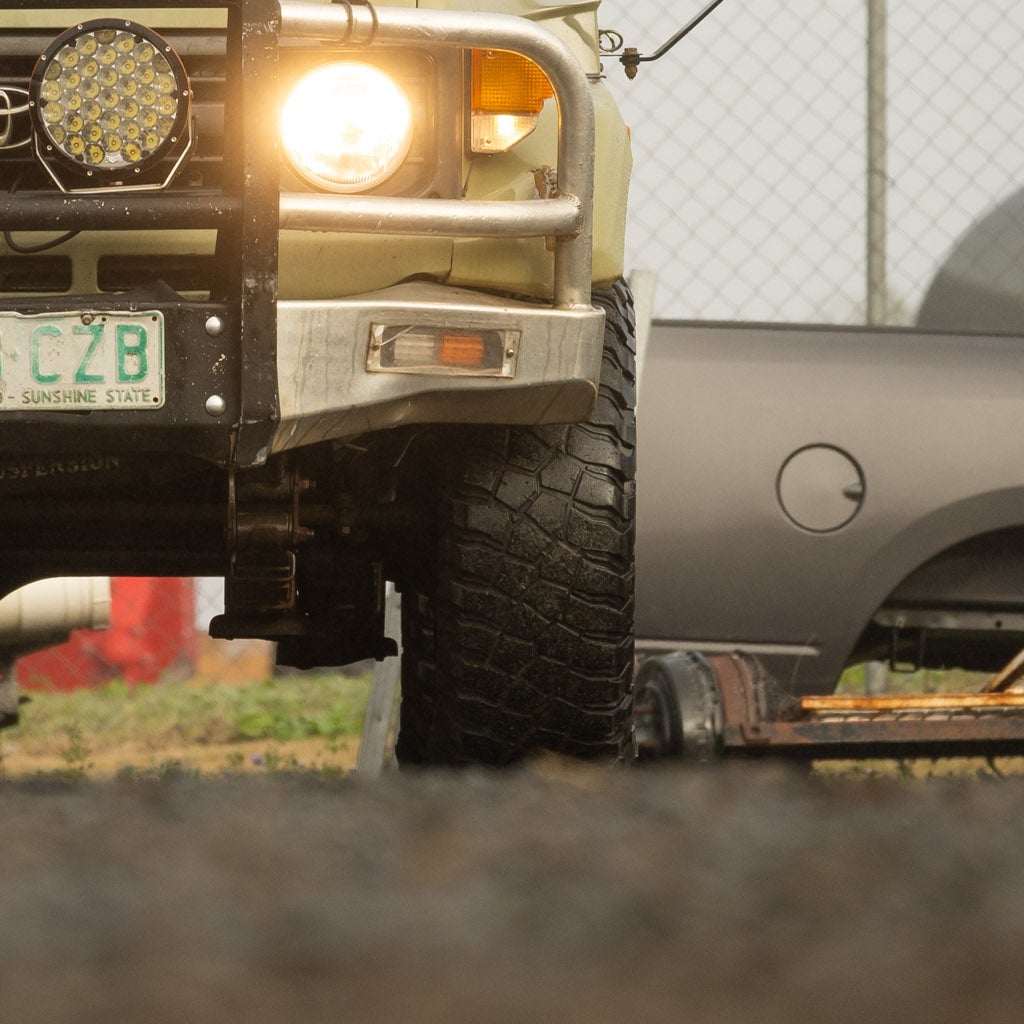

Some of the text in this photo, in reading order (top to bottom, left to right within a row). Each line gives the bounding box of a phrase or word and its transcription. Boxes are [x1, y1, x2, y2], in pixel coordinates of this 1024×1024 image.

[31, 324, 148, 384] CZB
[22, 388, 97, 404] SUNSHINE
[106, 388, 152, 403] STATE
